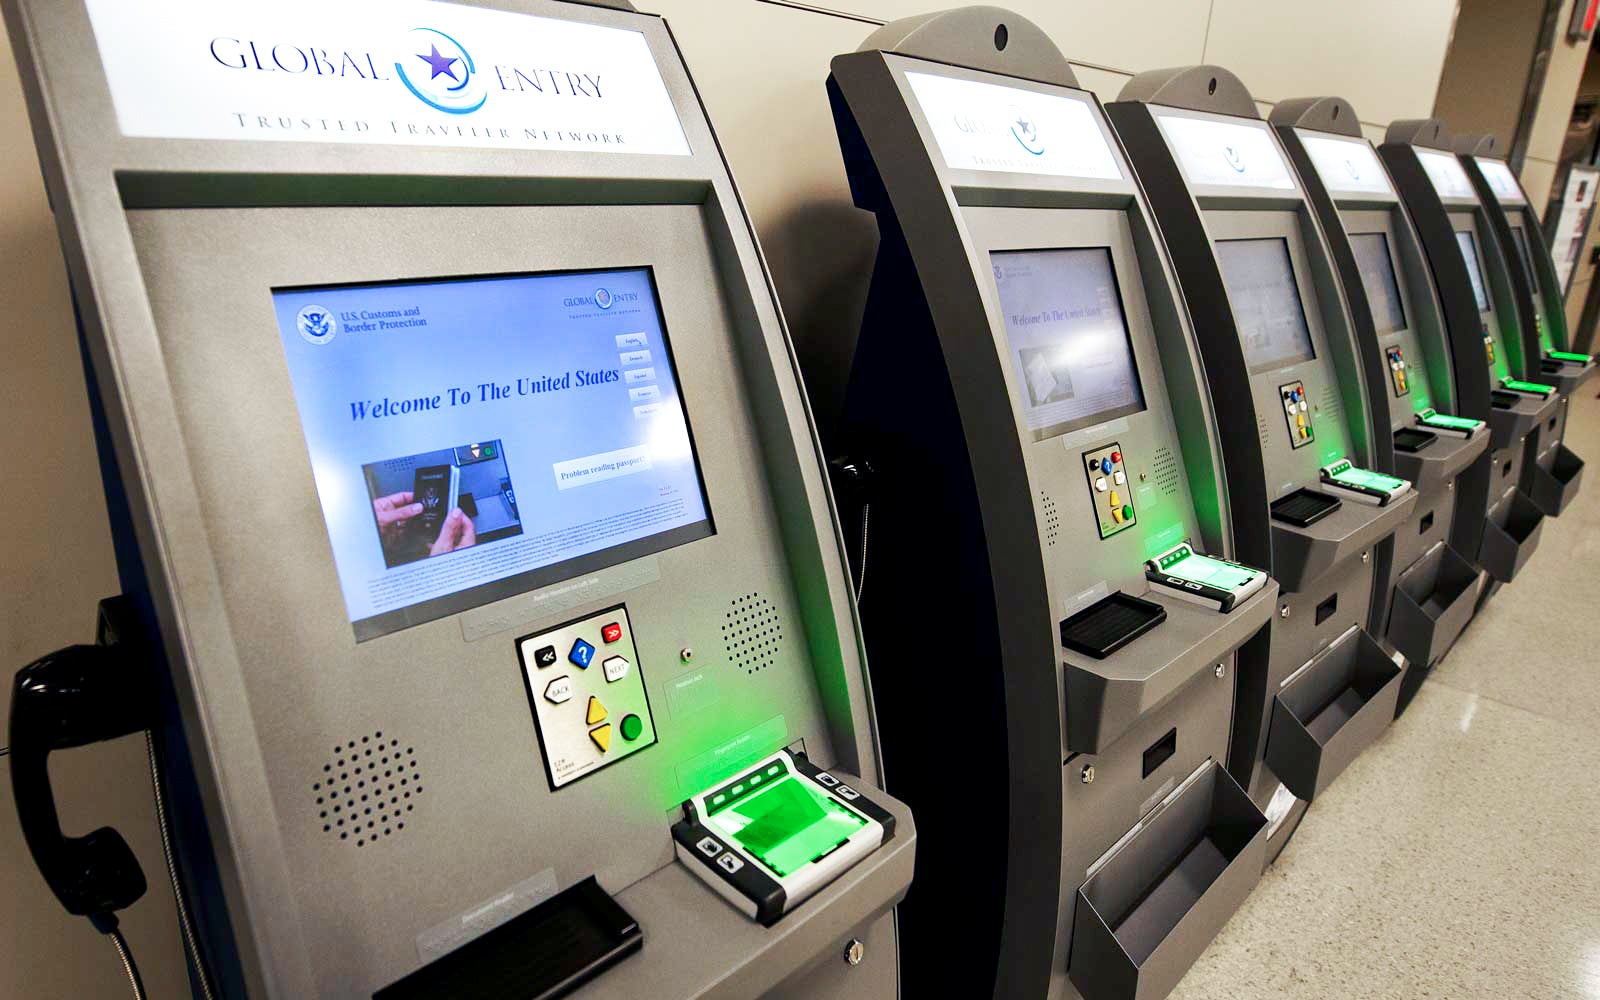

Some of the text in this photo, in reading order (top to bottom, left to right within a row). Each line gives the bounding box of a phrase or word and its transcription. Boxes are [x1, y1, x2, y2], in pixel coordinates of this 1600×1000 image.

[210, 37, 604, 99] GLOBAL ENTRY
[233, 112, 627, 145] TRUSTED TRAVELER NETWORK
[563, 291, 639, 307] GLOBAL ENTRY
[340, 306, 421, 322] U.S. Customs and
[1012, 314, 1041, 326] Welcome
[343, 318, 427, 334] Border Protection
[350, 367, 619, 421] Welcome To The United States
[560, 468, 590, 481] Problem
[590, 463, 616, 474] reading
[609, 663, 626, 674] NEXT
[551, 685, 569, 697] BACK
